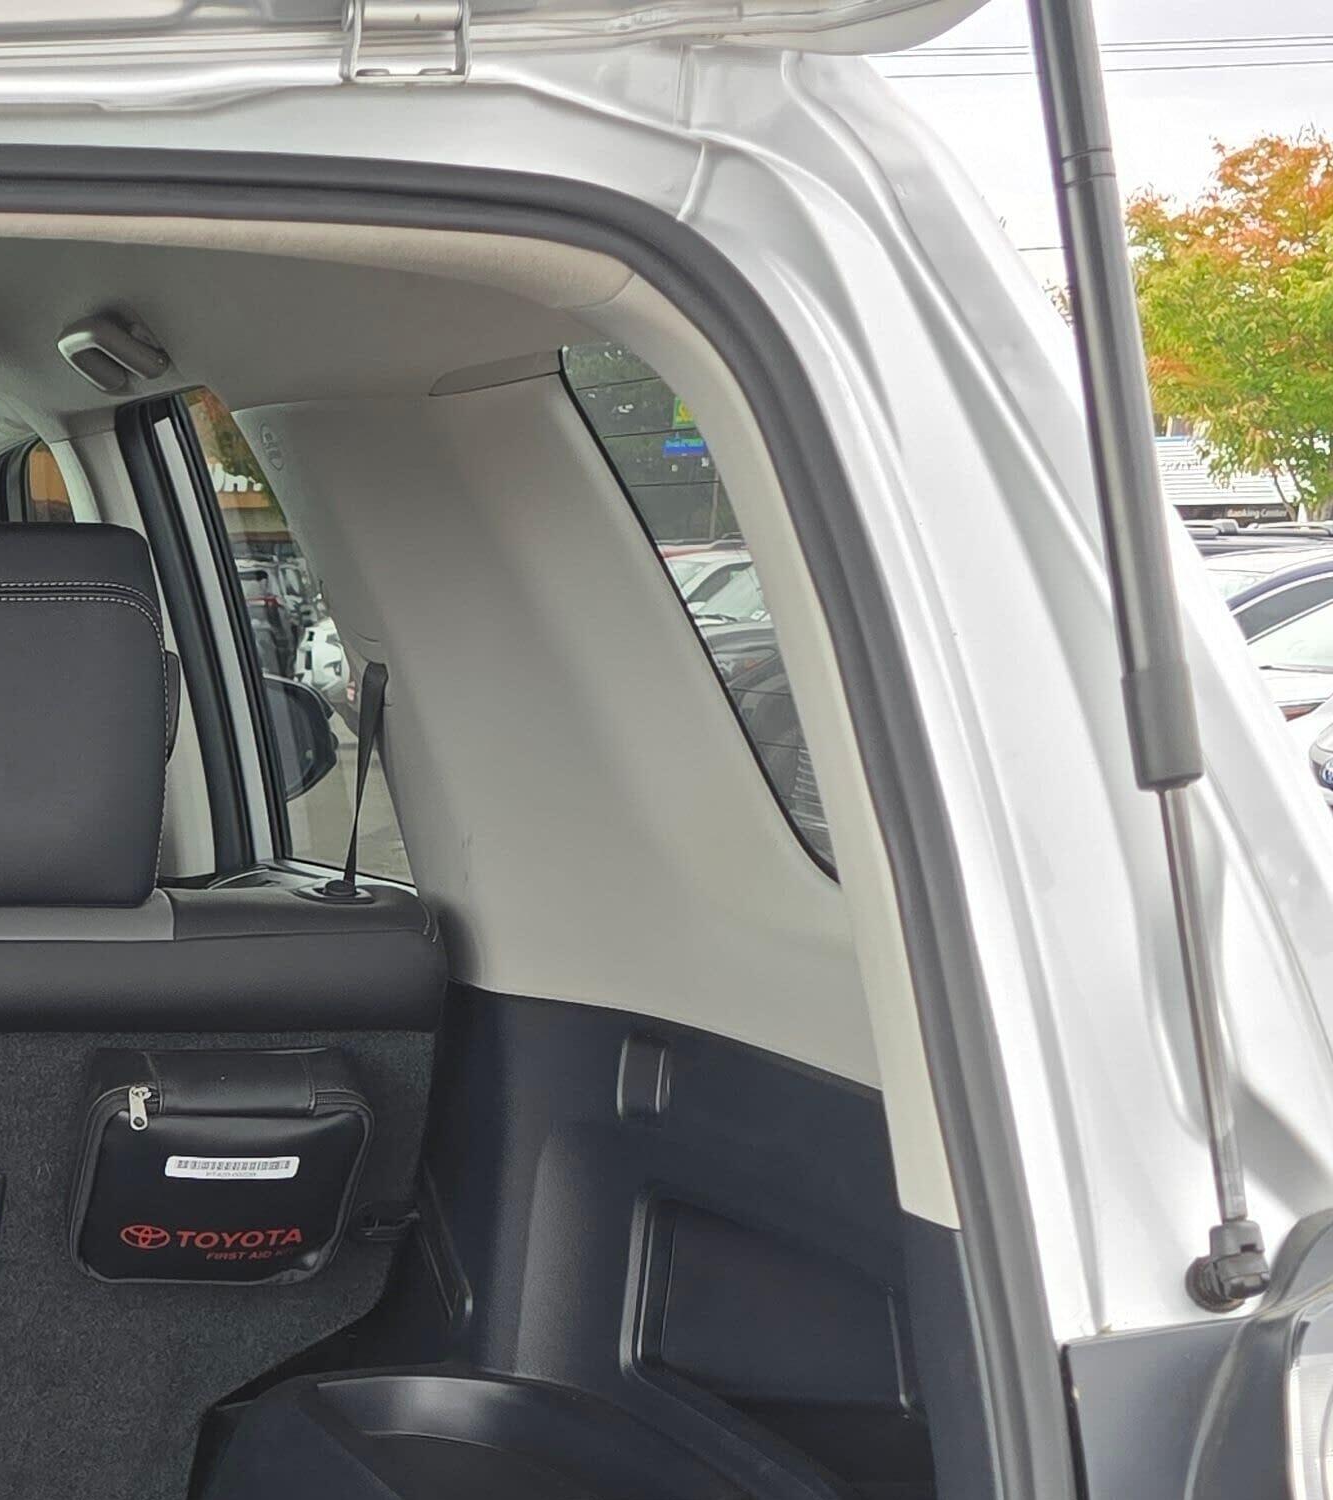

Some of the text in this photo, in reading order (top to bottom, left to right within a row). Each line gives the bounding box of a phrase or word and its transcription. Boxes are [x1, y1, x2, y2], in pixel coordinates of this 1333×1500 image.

[176, 1228, 303, 1249] TOYOTA
[206, 1251, 247, 1260] FIRST
[248, 1250, 272, 1259] AID
